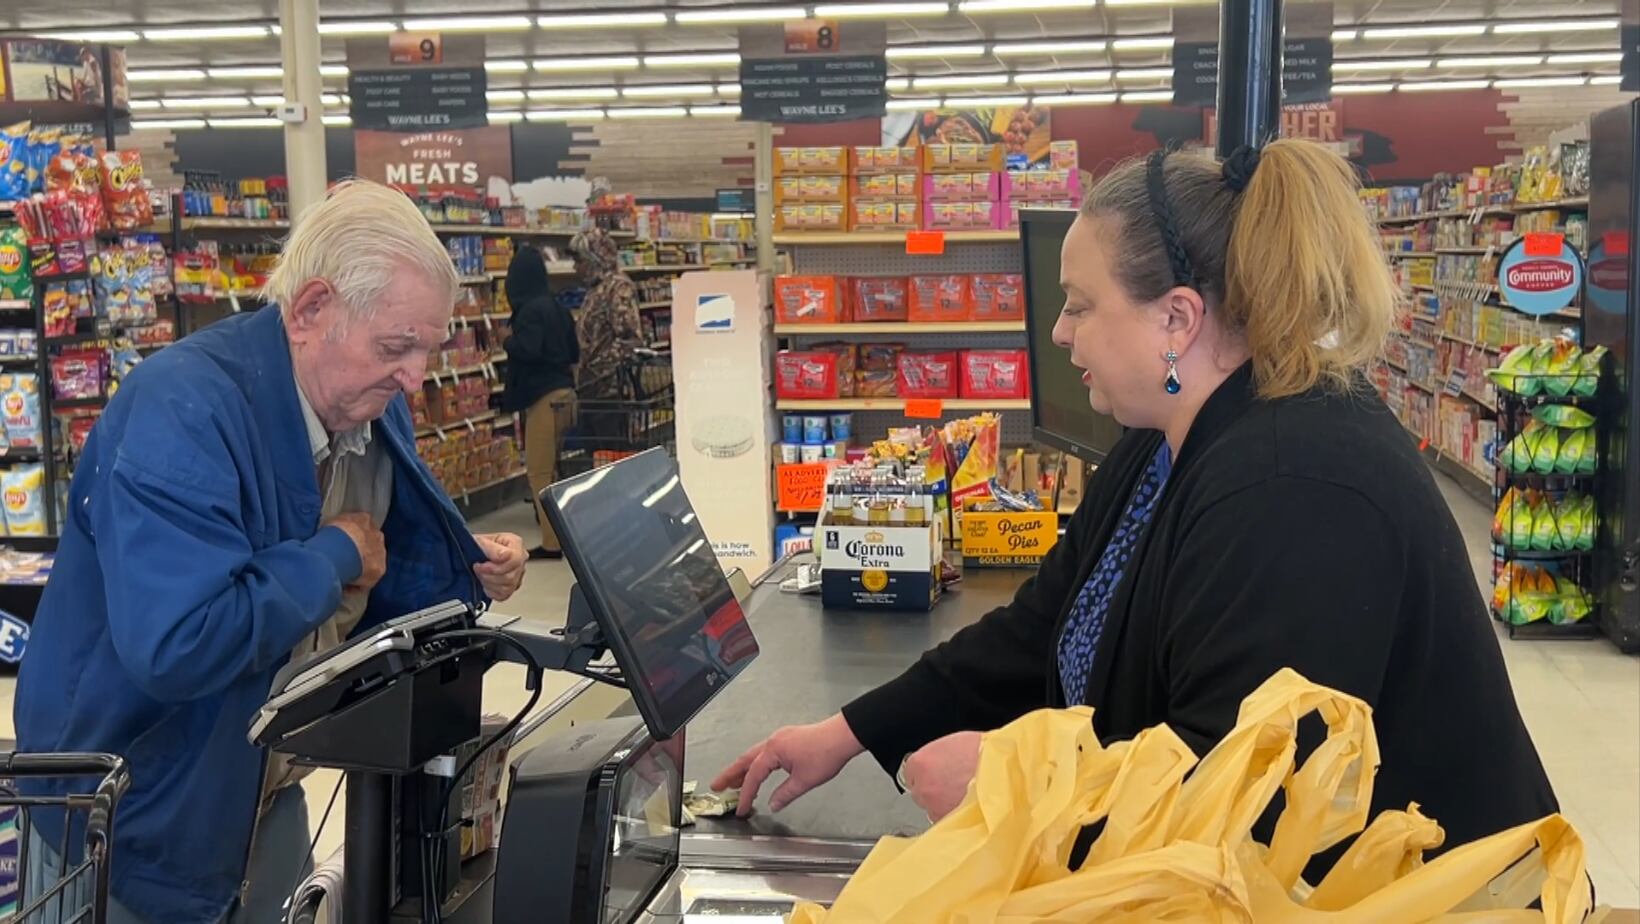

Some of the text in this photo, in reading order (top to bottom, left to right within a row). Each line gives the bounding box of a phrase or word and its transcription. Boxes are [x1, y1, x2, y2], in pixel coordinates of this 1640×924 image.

[817, 26, 833, 49] 8
[420, 39, 435, 60] 9
[1198, 47, 1218, 55] SNAC
[1193, 60, 1217, 70] CRACK
[1195, 75, 1217, 84] COOK
[780, 105, 847, 116] WAYNE LEE'S
[387, 114, 450, 125] WAYNE LEE'S
[400, 133, 434, 147] WAYNE
[413, 149, 451, 159] FRESH
[385, 162, 479, 185] MEATS
[1508, 267, 1572, 286] Community
[998, 519, 1043, 536] Pecan
[1008, 534, 1039, 551] Pies
[845, 539, 906, 561] Corona
[860, 556, 890, 568] Extra
[979, 555, 1041, 564] GOLDEN EAGLE
